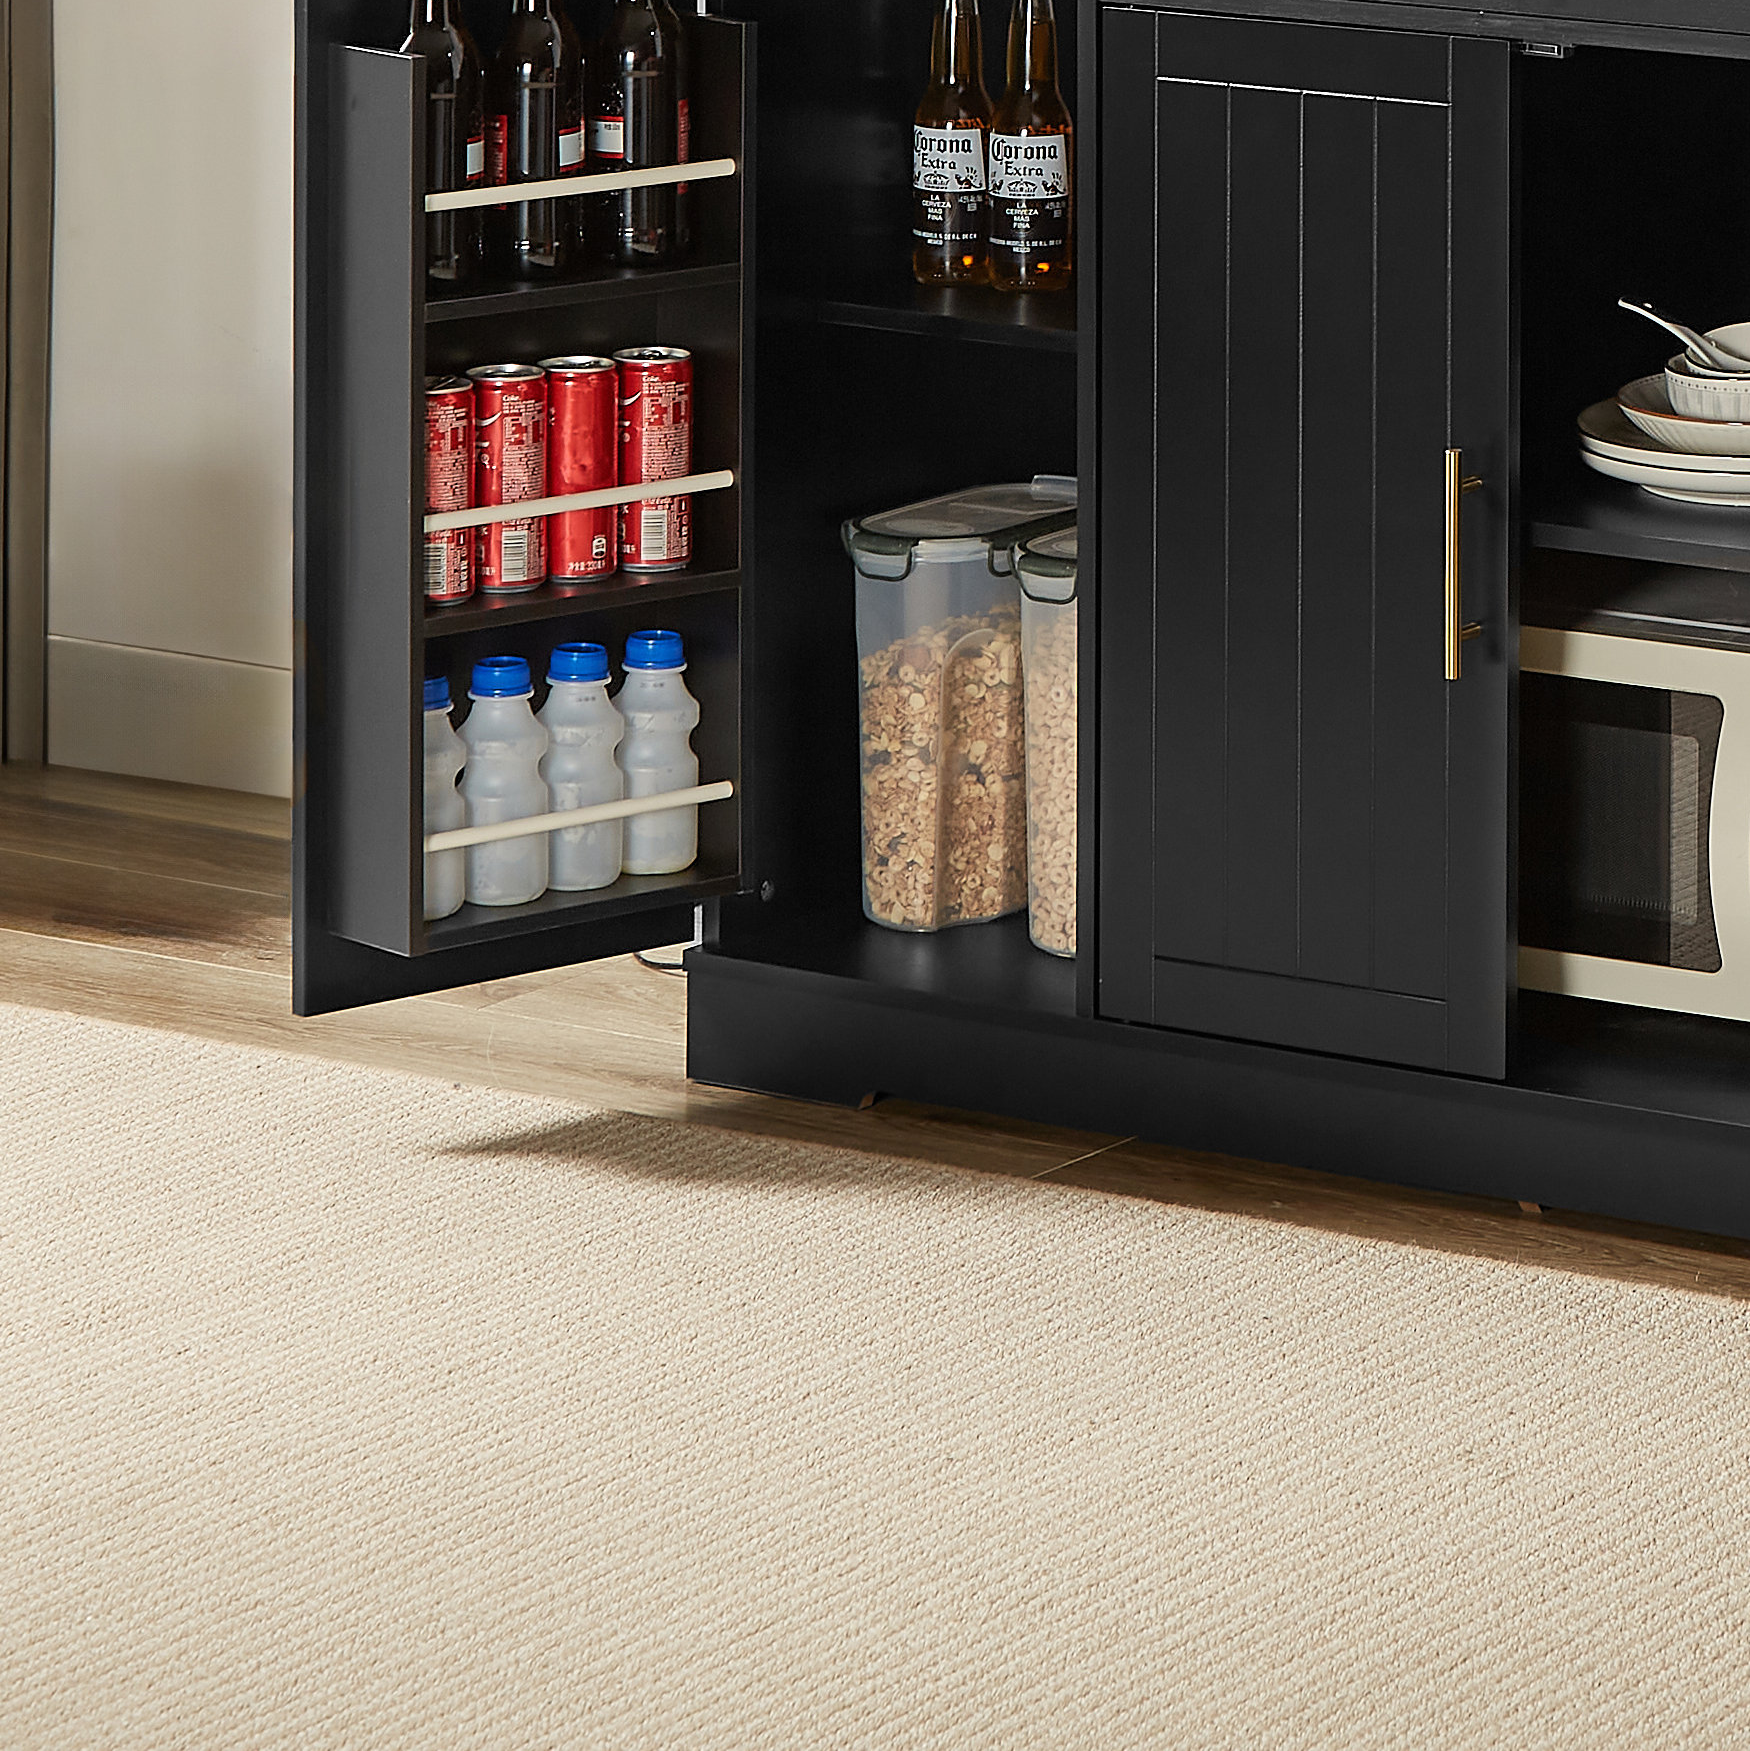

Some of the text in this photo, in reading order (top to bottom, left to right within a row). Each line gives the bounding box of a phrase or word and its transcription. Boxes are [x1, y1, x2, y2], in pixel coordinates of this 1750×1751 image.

[914, 130, 973, 154] Corona
[992, 137, 1059, 163] Corona
[921, 152, 957, 170] Extra
[1004, 160, 1044, 177] Extra
